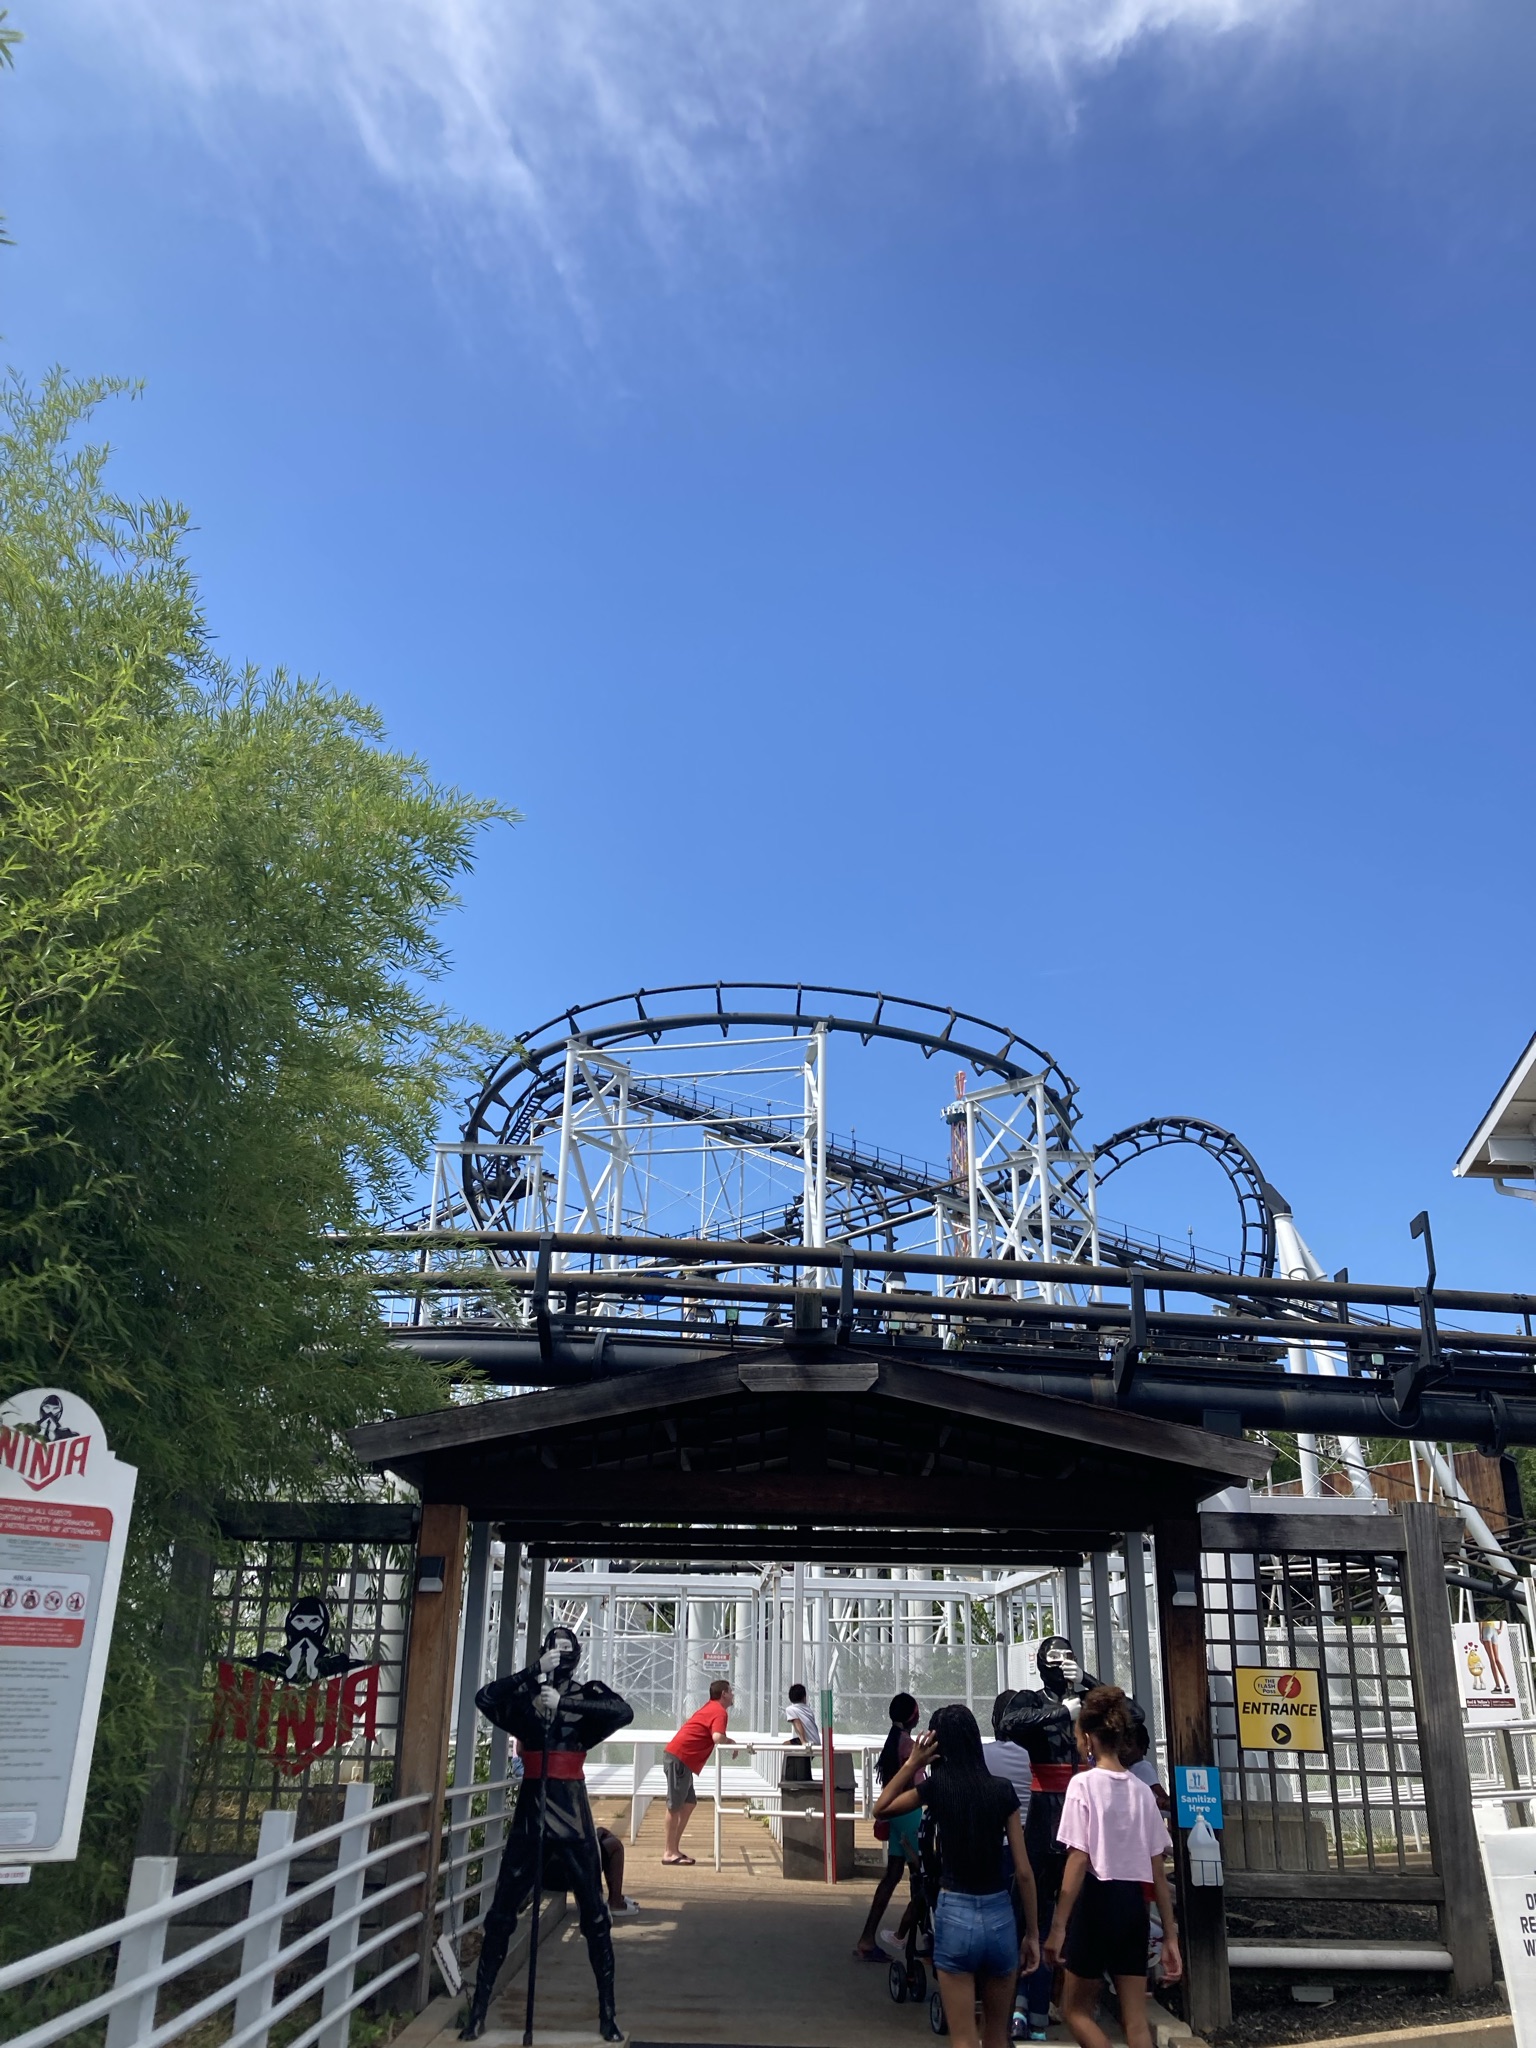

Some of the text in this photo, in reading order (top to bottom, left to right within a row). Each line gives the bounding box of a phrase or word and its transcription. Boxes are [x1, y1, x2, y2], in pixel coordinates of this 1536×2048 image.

[0, 1424, 91, 1492] NINJA
[208, 1660, 380, 1777] NINJA
[1242, 1701, 1318, 1717] ENTRANCE
[1181, 1794, 1217, 1804] Sanitize
